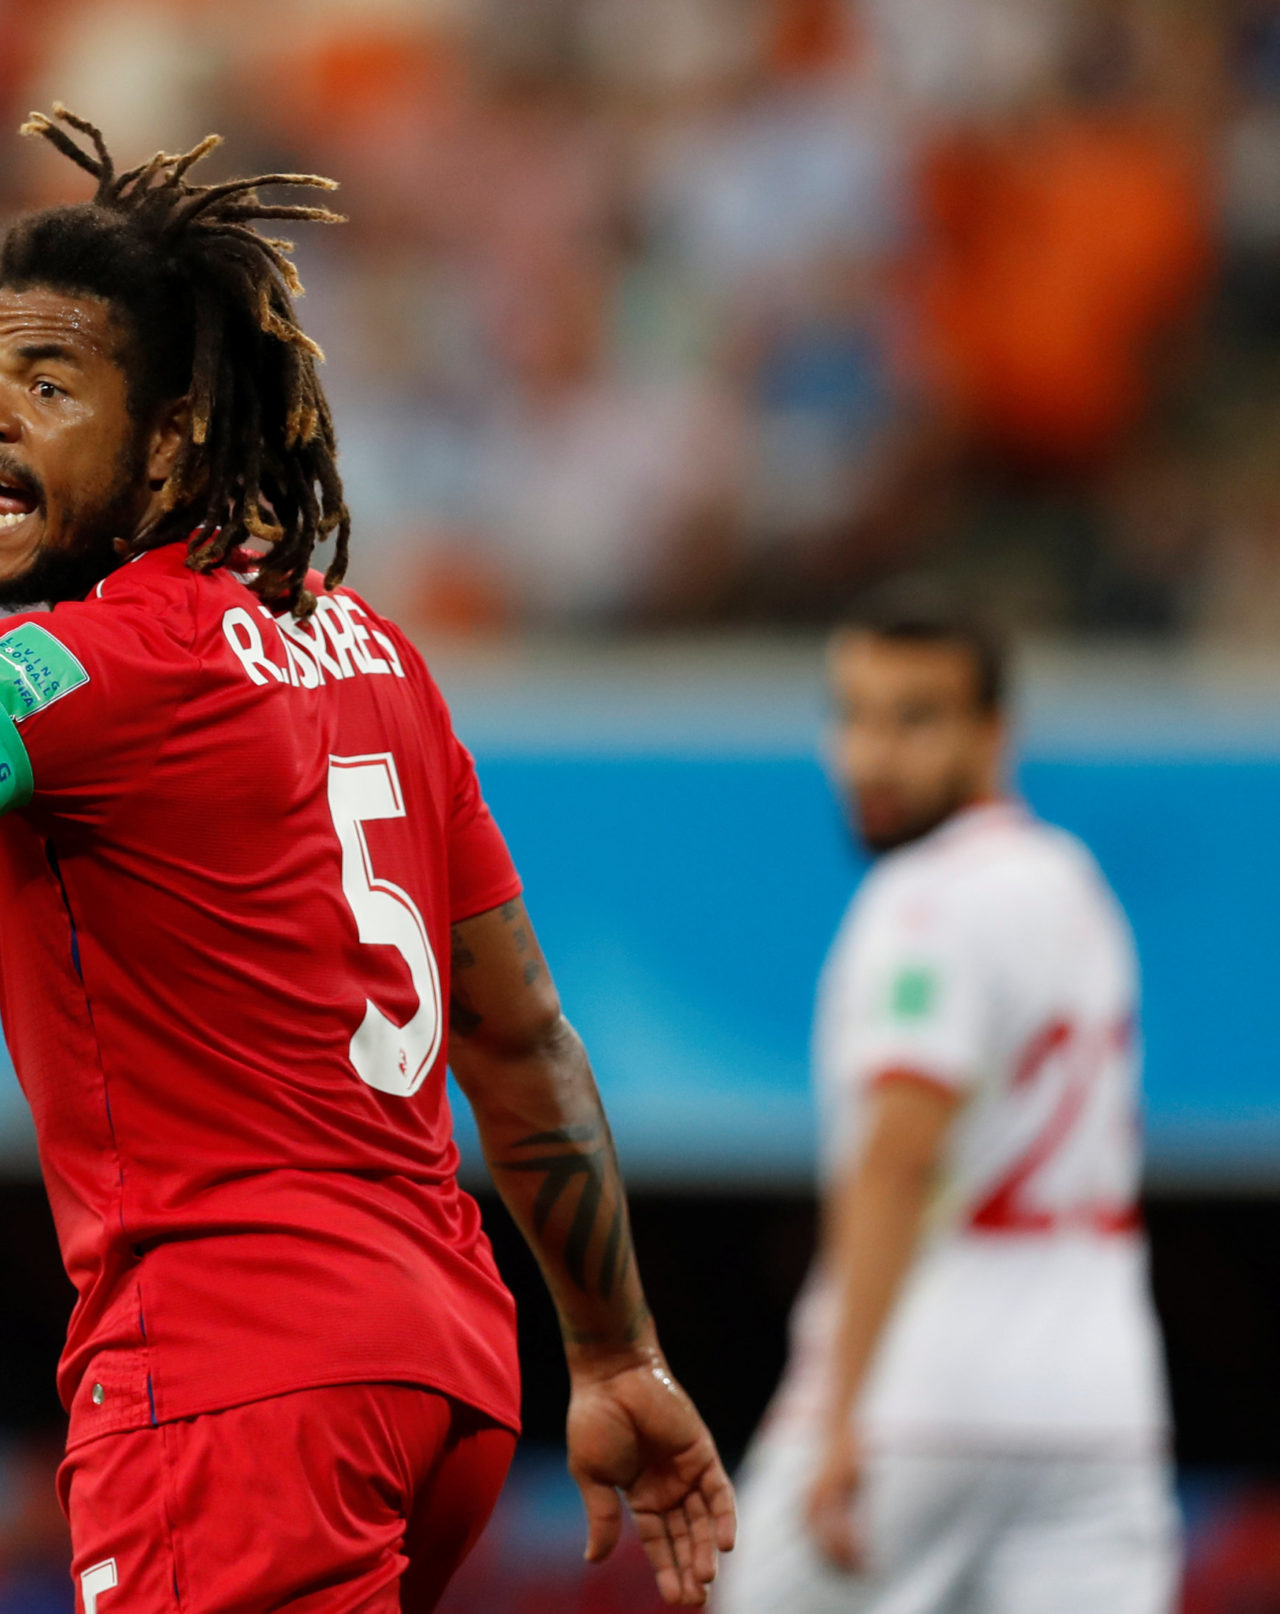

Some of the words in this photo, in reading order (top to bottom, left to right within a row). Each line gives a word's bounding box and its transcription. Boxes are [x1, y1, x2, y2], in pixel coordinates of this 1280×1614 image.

[5, 637, 60, 691] LIVING
[13, 678, 34, 708] FIFA
[326, 751, 443, 1098] 5
